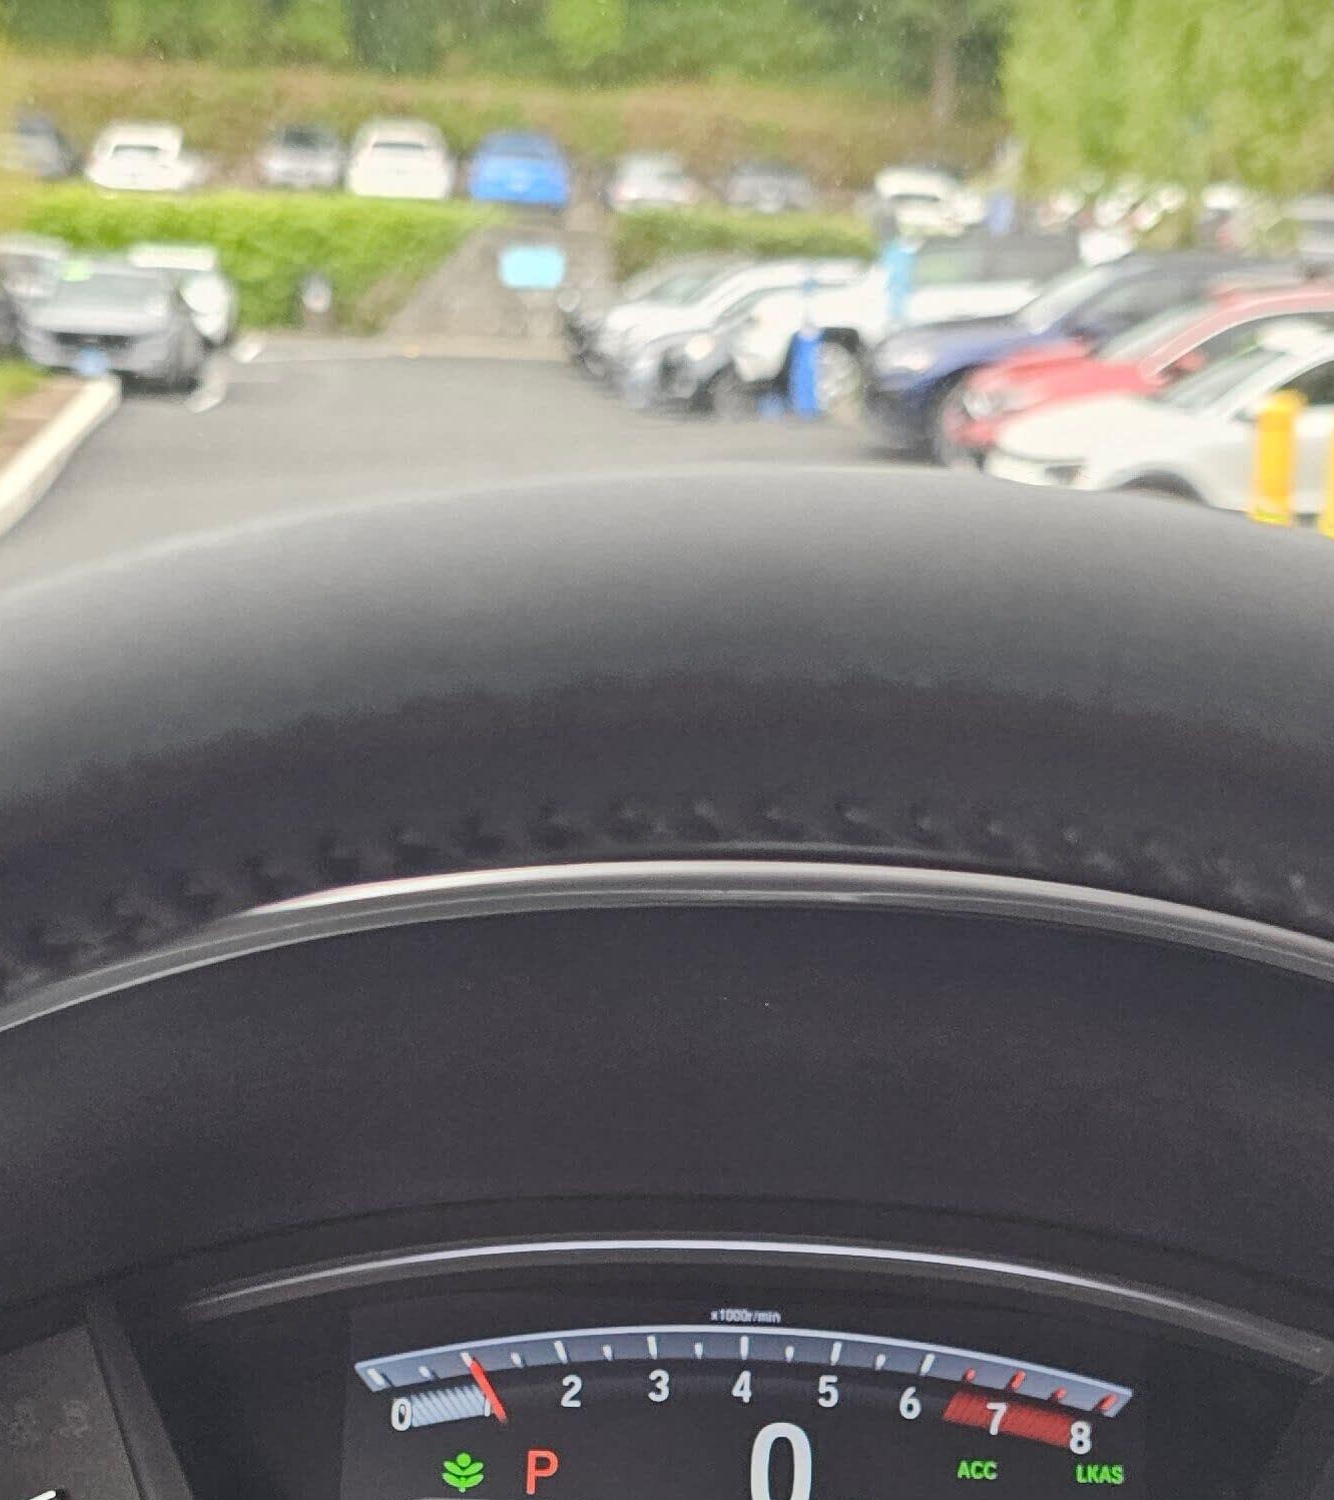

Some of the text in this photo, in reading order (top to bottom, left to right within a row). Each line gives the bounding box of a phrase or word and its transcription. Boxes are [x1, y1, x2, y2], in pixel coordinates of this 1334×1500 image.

[390, 1396, 413, 1431] 0
[560, 1374, 582, 1408] 2
[648, 1368, 670, 1402] 3
[731, 1370, 753, 1404] 4
[817, 1375, 839, 1408] 5
[899, 1386, 922, 1420] 6
[986, 1401, 1008, 1436] 7
[1069, 1420, 1092, 1455] 8
[525, 1450, 559, 1496] P
[956, 1459, 998, 1480] ACC
[1075, 1463, 1124, 1485] LKAS
